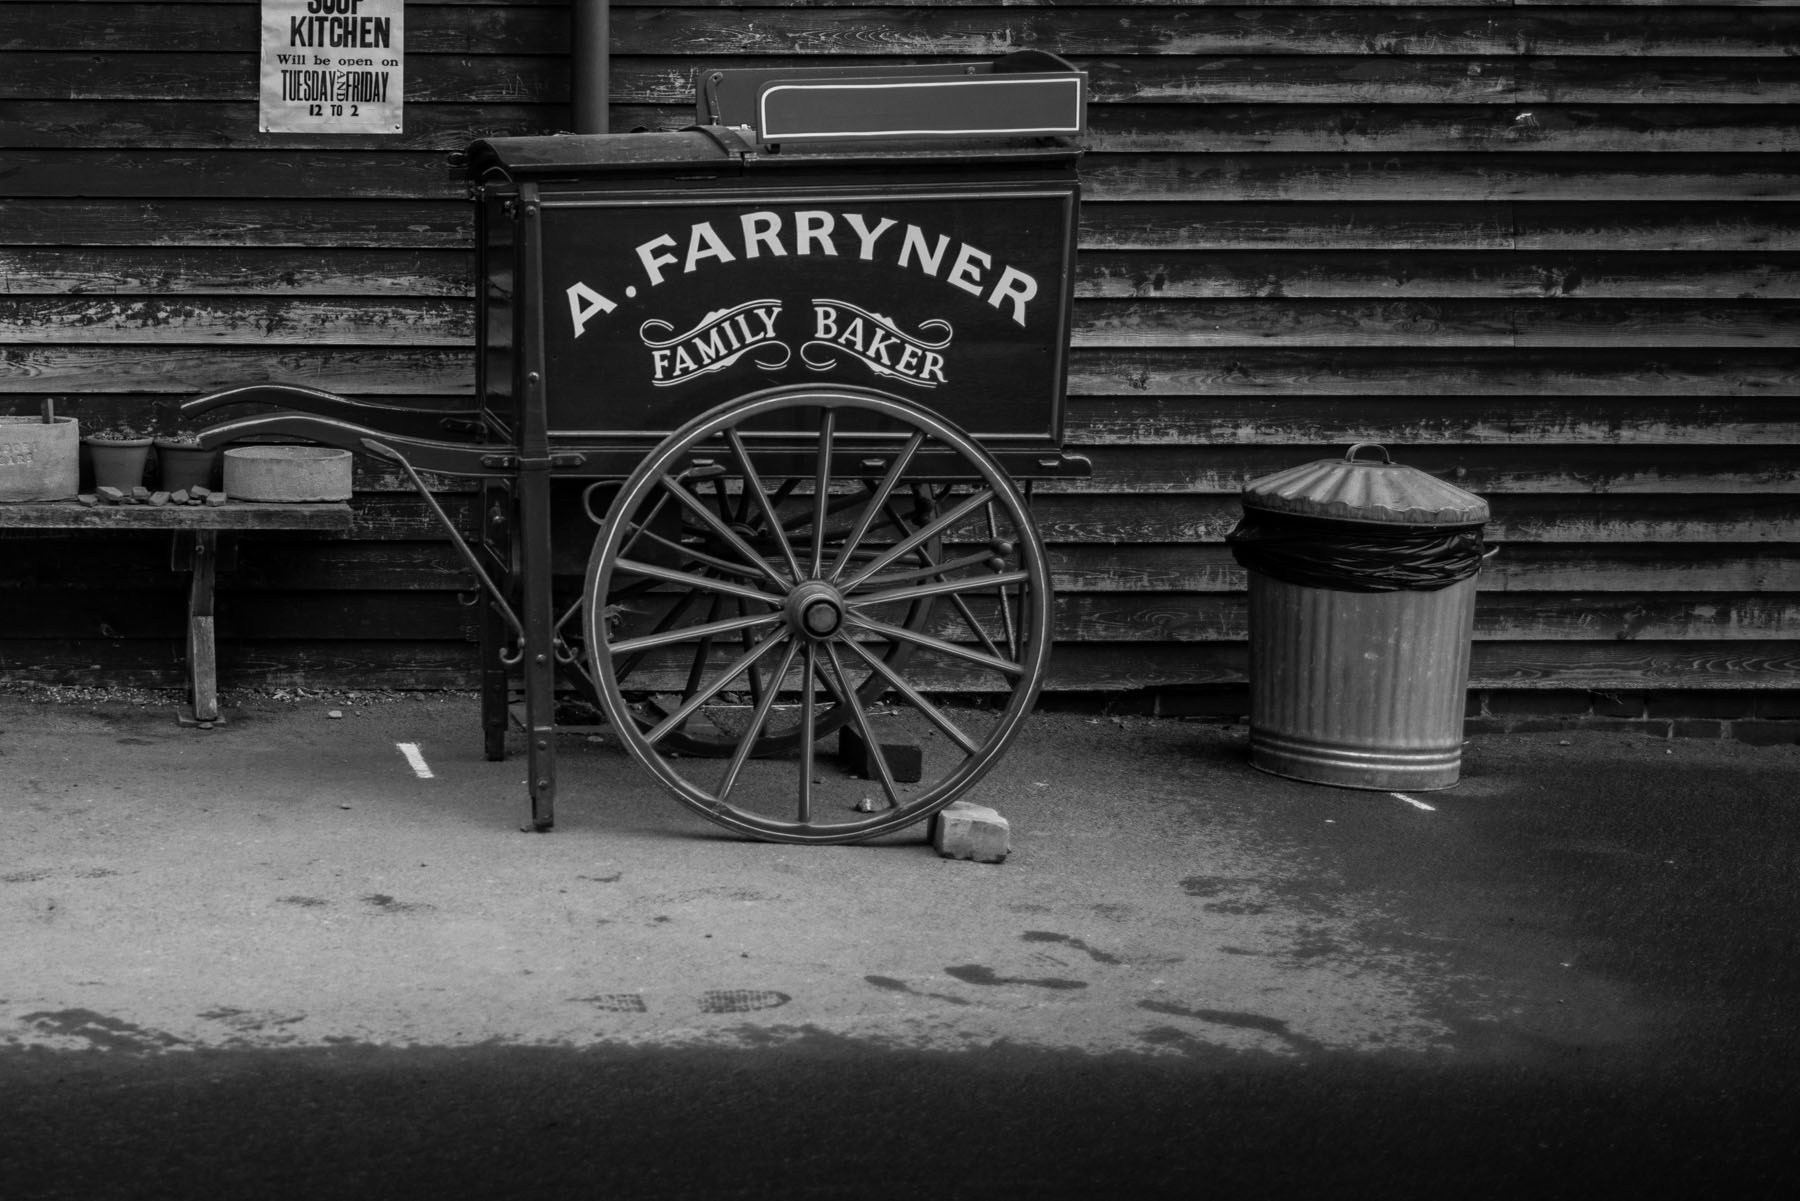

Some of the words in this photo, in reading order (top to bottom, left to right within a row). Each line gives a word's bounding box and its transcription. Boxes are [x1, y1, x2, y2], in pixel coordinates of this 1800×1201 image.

[290, 16, 390, 48] KITCHEN
[277, 54, 305, 65] Will
[314, 56, 331, 65] be
[339, 57, 373, 66] open
[382, 58, 399, 66] on
[281, 70, 336, 101] TUESDAY
[337, 69, 345, 101] AND
[346, 71, 389, 103] FRIDAY
[309, 104, 323, 116] 12
[331, 104, 342, 116] TO
[351, 105, 359, 116] 2
[651, 307, 782, 379] FAMILY
[814, 307, 948, 383] BAKER
